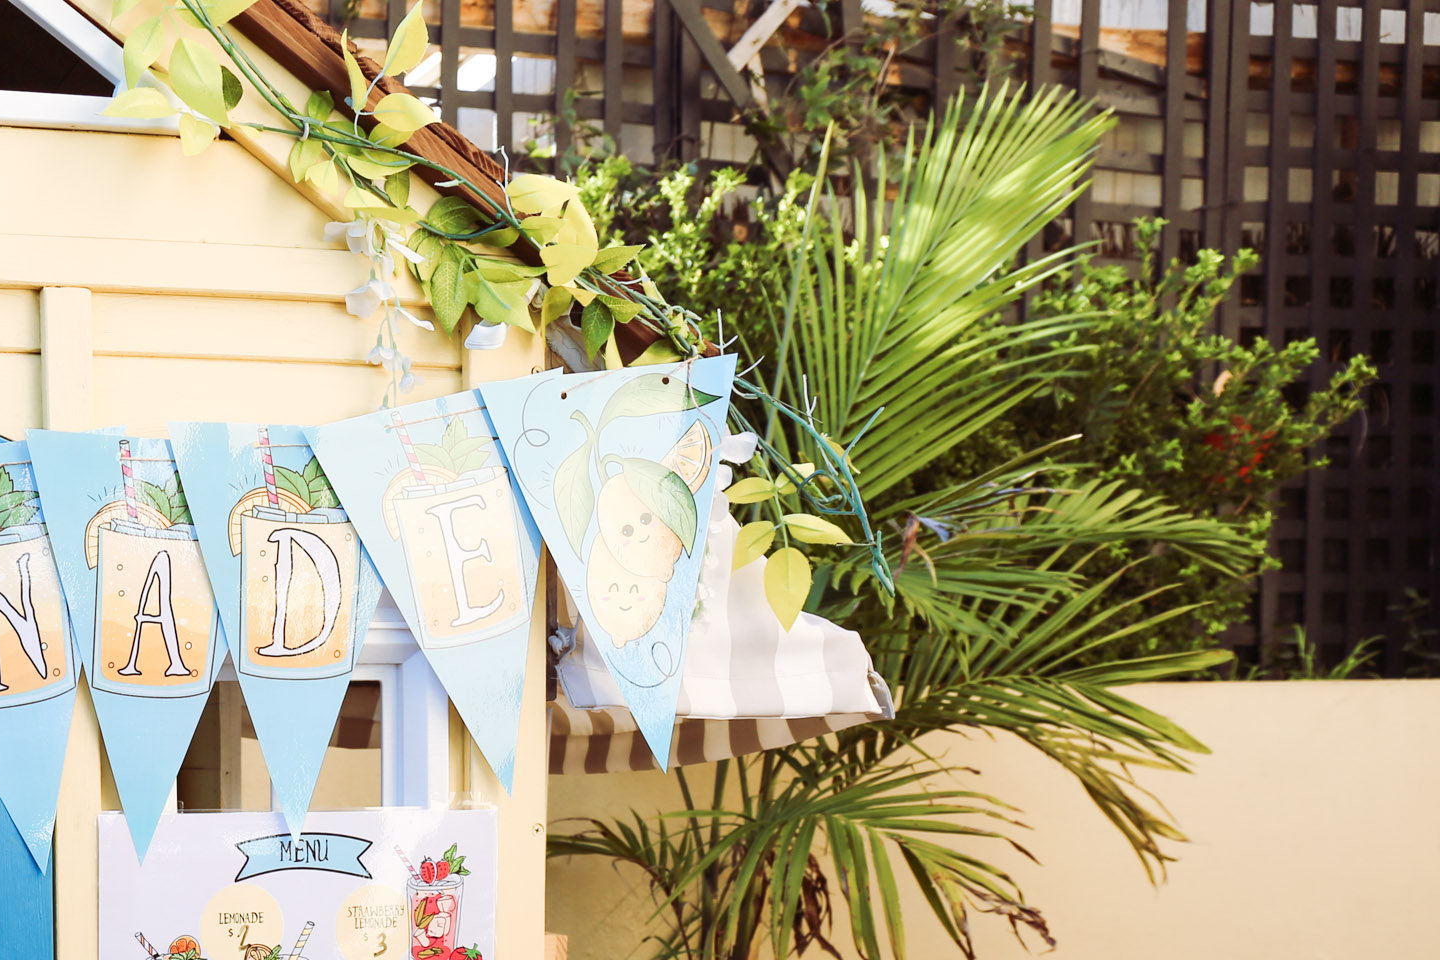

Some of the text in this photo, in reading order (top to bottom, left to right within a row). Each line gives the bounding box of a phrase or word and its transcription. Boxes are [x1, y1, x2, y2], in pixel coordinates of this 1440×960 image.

[280, 839, 329, 863] MENU
[218, 911, 264, 924] LEMONADE
[347, 904, 405, 918] STRAWBERRY
[354, 916, 398, 930] LEMONADE
